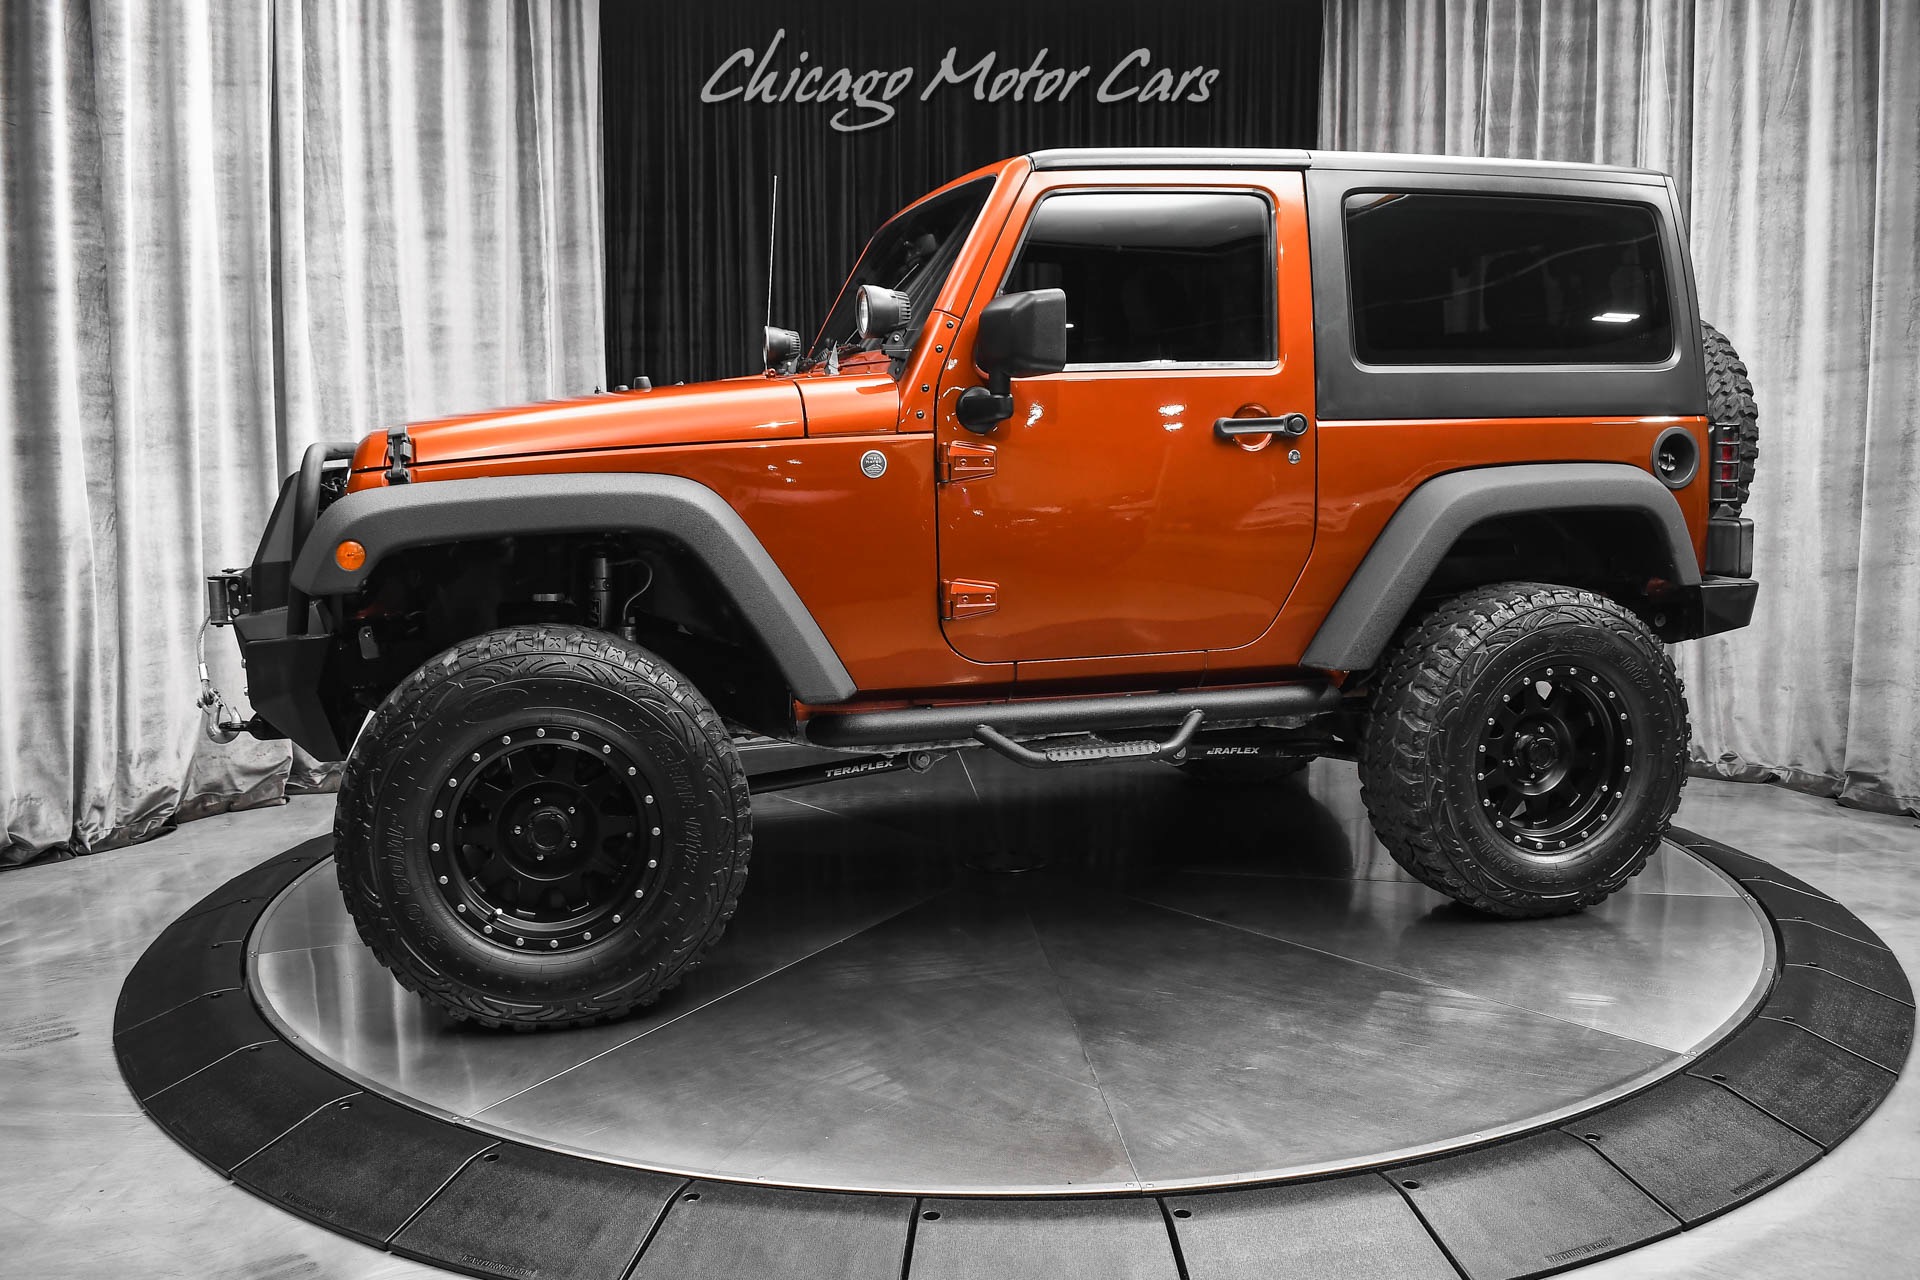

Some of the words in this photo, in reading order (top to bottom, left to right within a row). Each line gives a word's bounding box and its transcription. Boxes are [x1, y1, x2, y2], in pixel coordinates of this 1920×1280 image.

[700, 28, 914, 132] Chicago
[920, 46, 1091, 102] Motor
[1096, 47, 1220, 102] Cars
[825, 760, 893, 777] TERAFLEX
